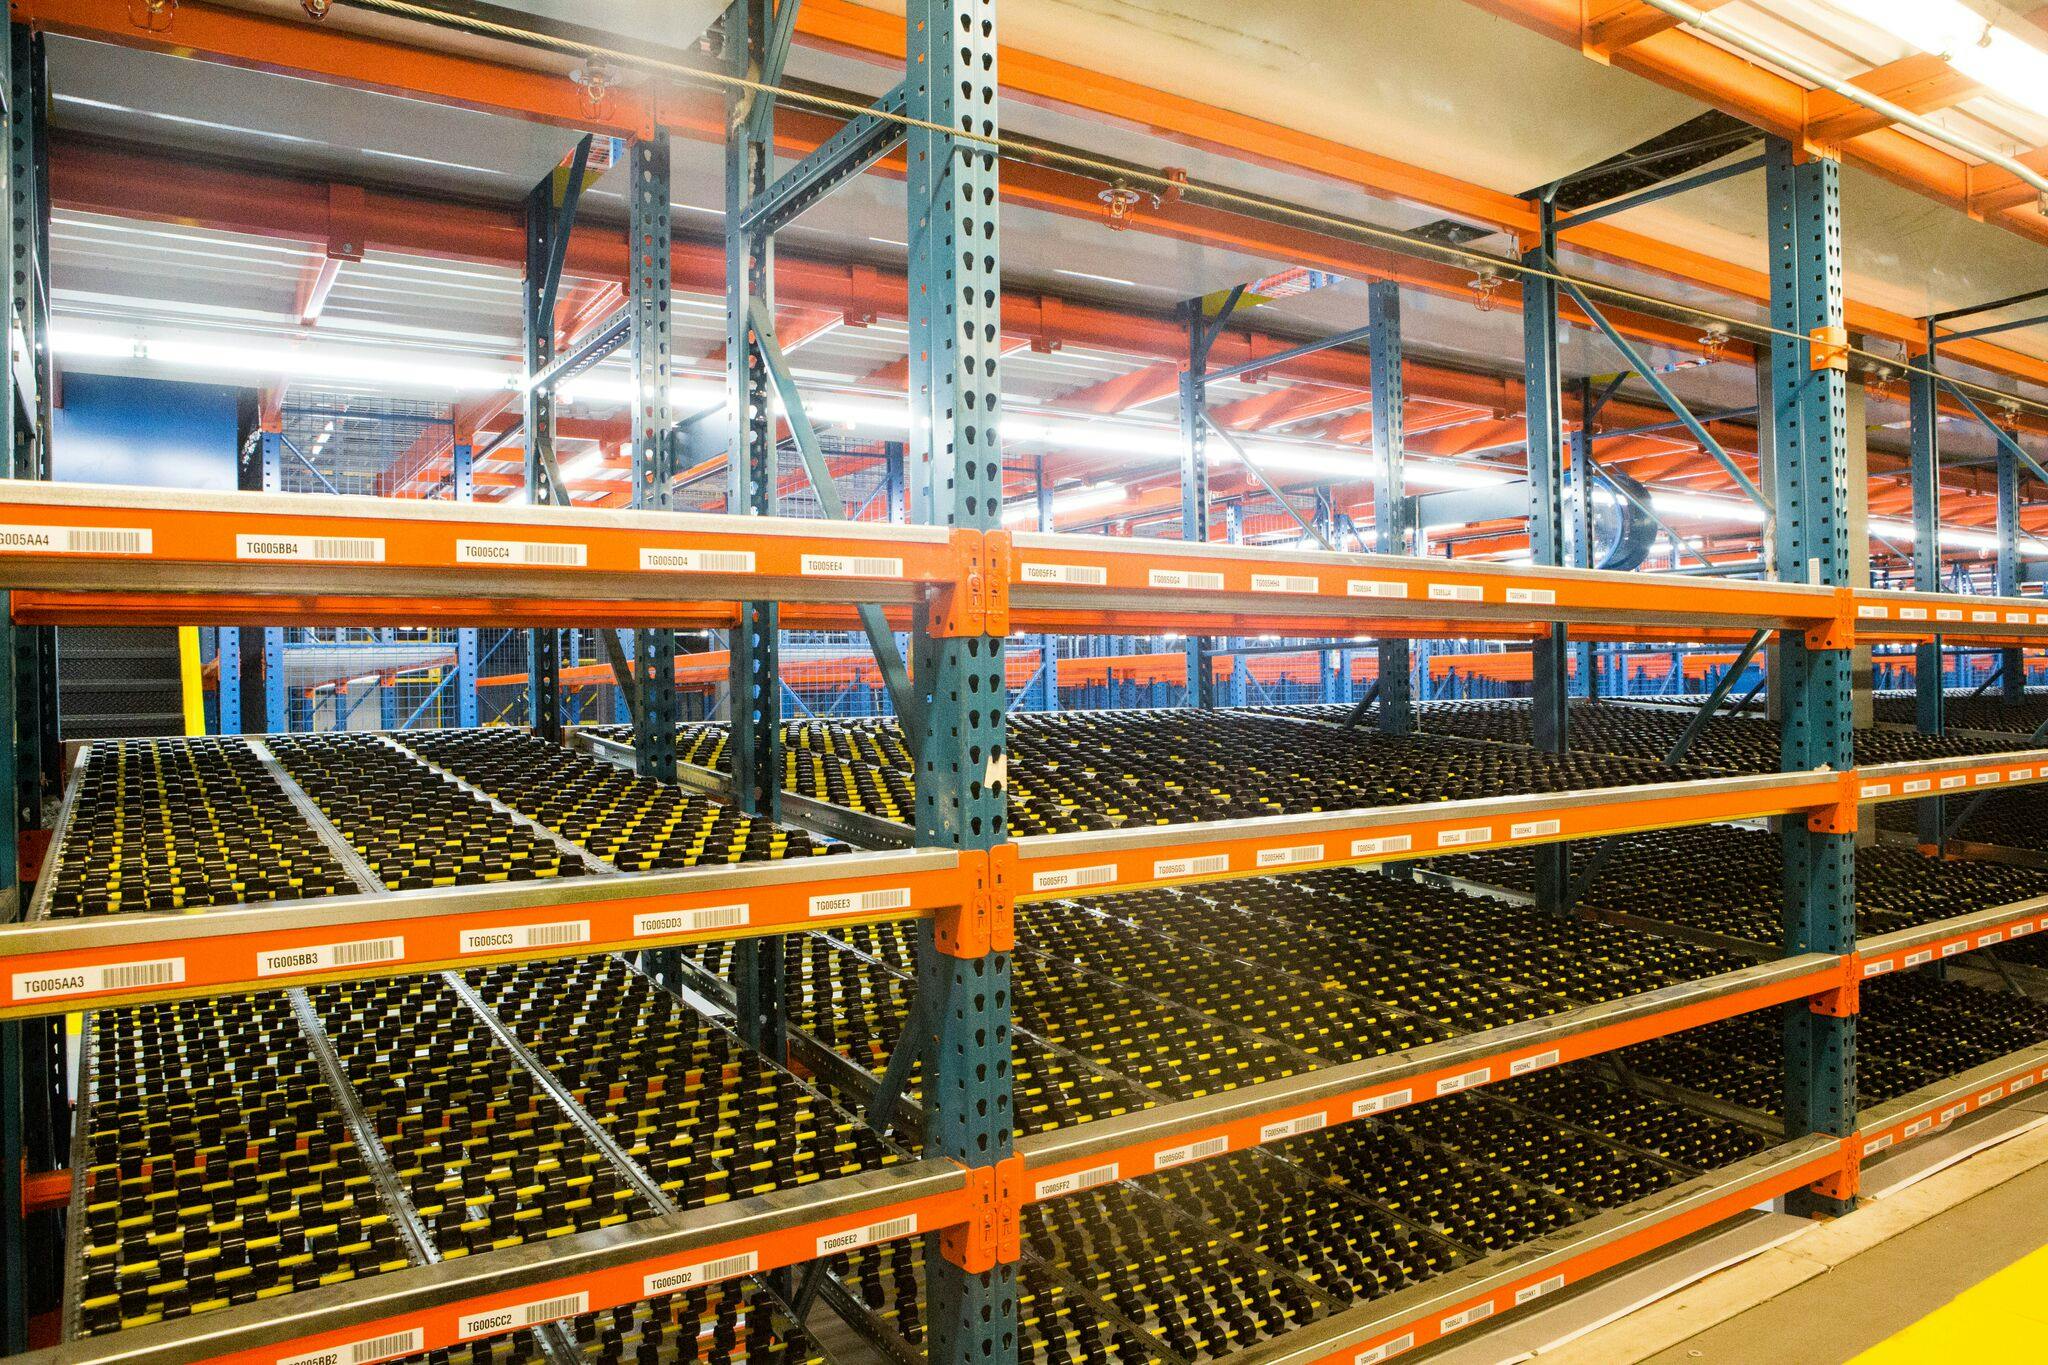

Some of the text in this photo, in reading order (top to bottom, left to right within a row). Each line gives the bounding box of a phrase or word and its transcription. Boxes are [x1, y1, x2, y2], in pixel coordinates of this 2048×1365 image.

[247, 542, 298, 554] TG005BB4
[466, 546, 510, 558] TG005CC4
[648, 556, 688, 566] TG005DD4
[808, 561, 842, 572] TG005EE4
[1028, 568, 1056, 578] TG005FF4
[1040, 875, 1068, 886] TG005FF3
[816, 898, 850, 911] TG005EE3
[641, 918, 682, 932] TG005DD3
[468, 934, 513, 948] TG005CC3
[267, 952, 318, 970] TG005BB3
[24, 976, 84, 993] TG005AA3
[1042, 1180, 1070, 1194] TG005FF2
[824, 1234, 858, 1250] TG005EE2
[652, 1272, 692, 1290] TG005DD2
[468, 1314, 512, 1333] TG005CC2
